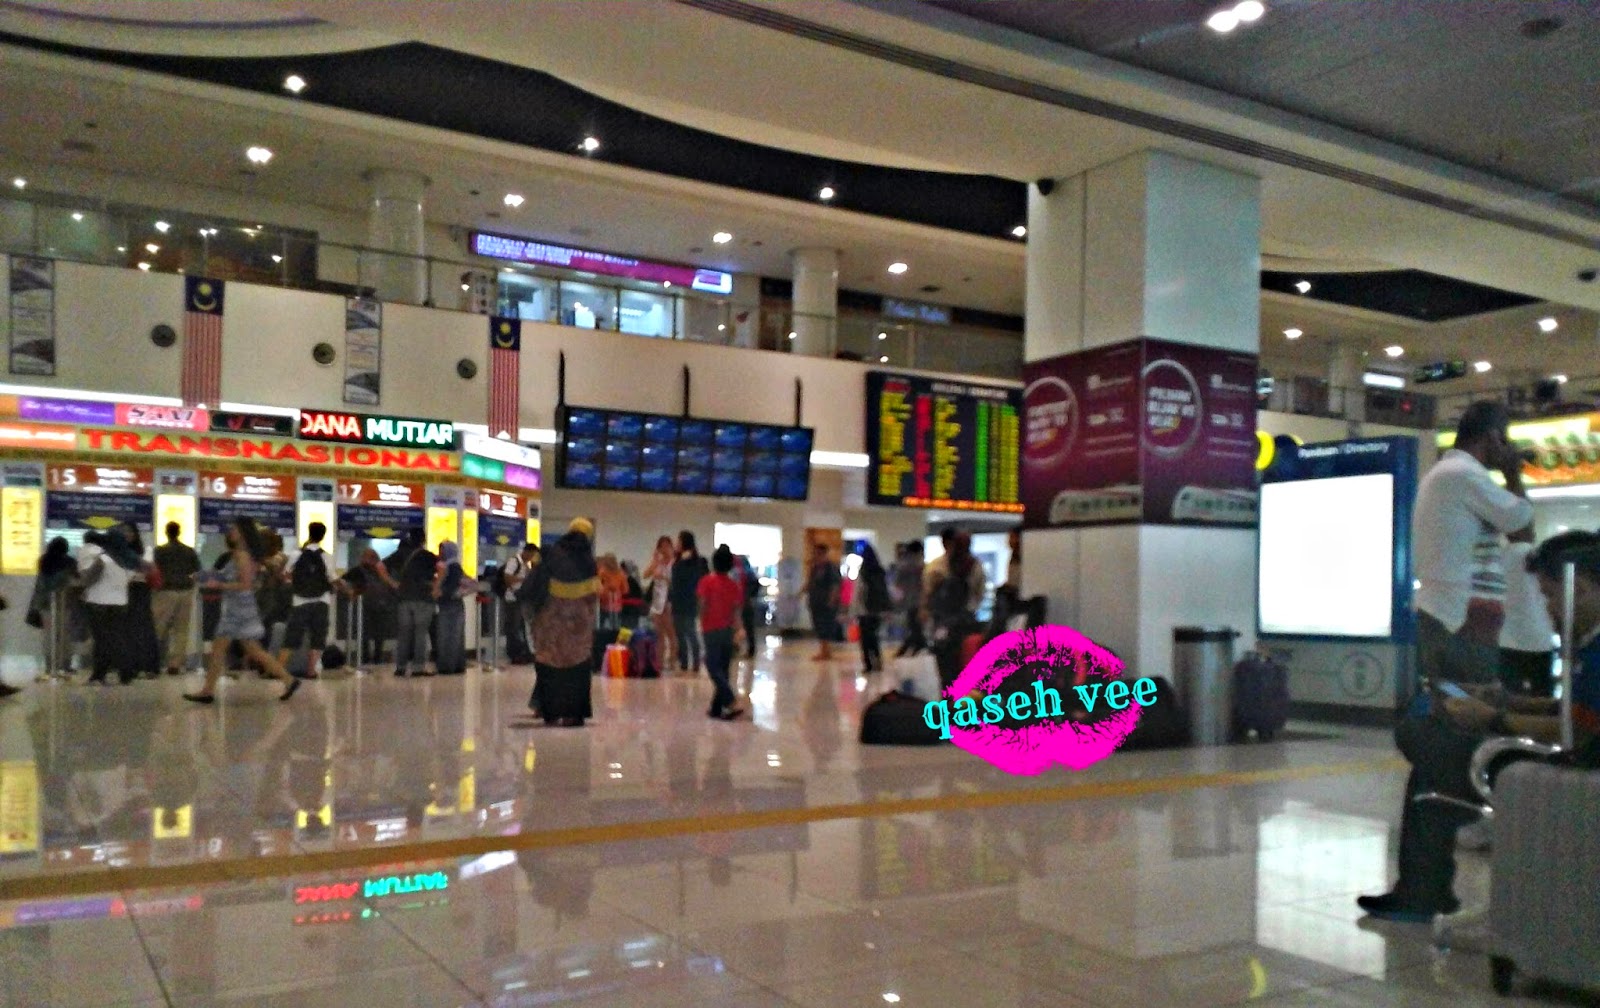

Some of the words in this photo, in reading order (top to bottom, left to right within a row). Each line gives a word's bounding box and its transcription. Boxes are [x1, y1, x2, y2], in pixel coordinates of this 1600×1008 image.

[80, 427, 461, 473] TRANSNASIONAL
[50, 467, 77, 486] 15
[202, 476, 227, 494] 16
[340, 483, 362, 500] 17
